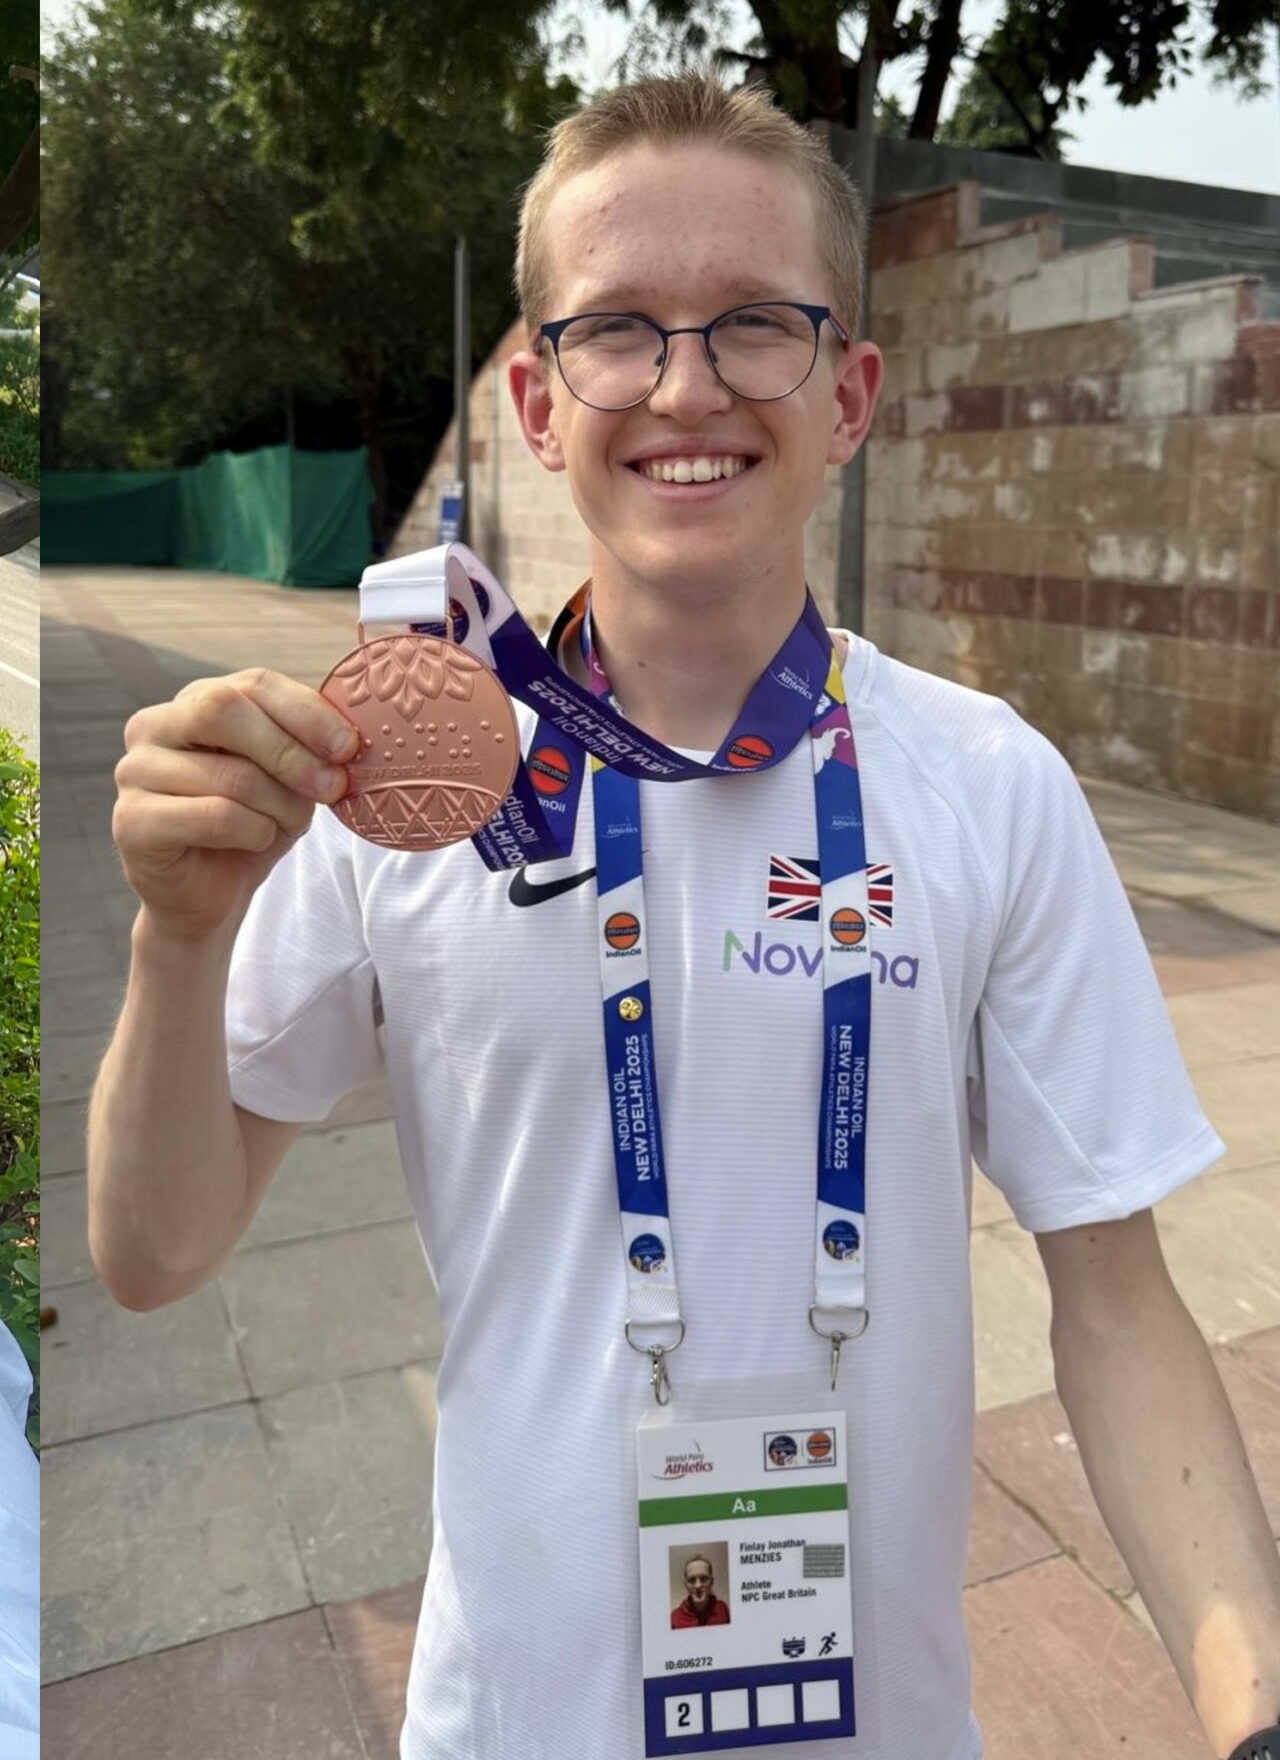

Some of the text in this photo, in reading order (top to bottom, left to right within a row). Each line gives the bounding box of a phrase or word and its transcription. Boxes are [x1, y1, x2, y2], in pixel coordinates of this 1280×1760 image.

[778, 671, 813, 700] Athletics
[528, 680, 676, 774] NEW DELHI 2025
[552, 716, 622, 764] IndianOil
[606, 948, 642, 958] IndianOil
[722, 930, 920, 989] Novna
[614, 1067, 631, 1152] INDIAN OIL
[625, 1035, 651, 1181] NEW DELHI 2025
[834, 1024, 852, 1170] NEW DELHI 2025
[851, 1056, 866, 1139] INDIAN OIL
[664, 1461, 713, 1475] Athletics
[732, 1498, 756, 1513] Aa
[740, 1540, 806, 1552] Finlay Jonathan
[740, 1552, 782, 1564] MENZIES
[741, 1580, 771, 1590] Athlete
[742, 1588, 816, 1602] NPC Great Britain
[664, 1656, 713, 1671] ID:606272
[677, 1702, 690, 1727] 2
